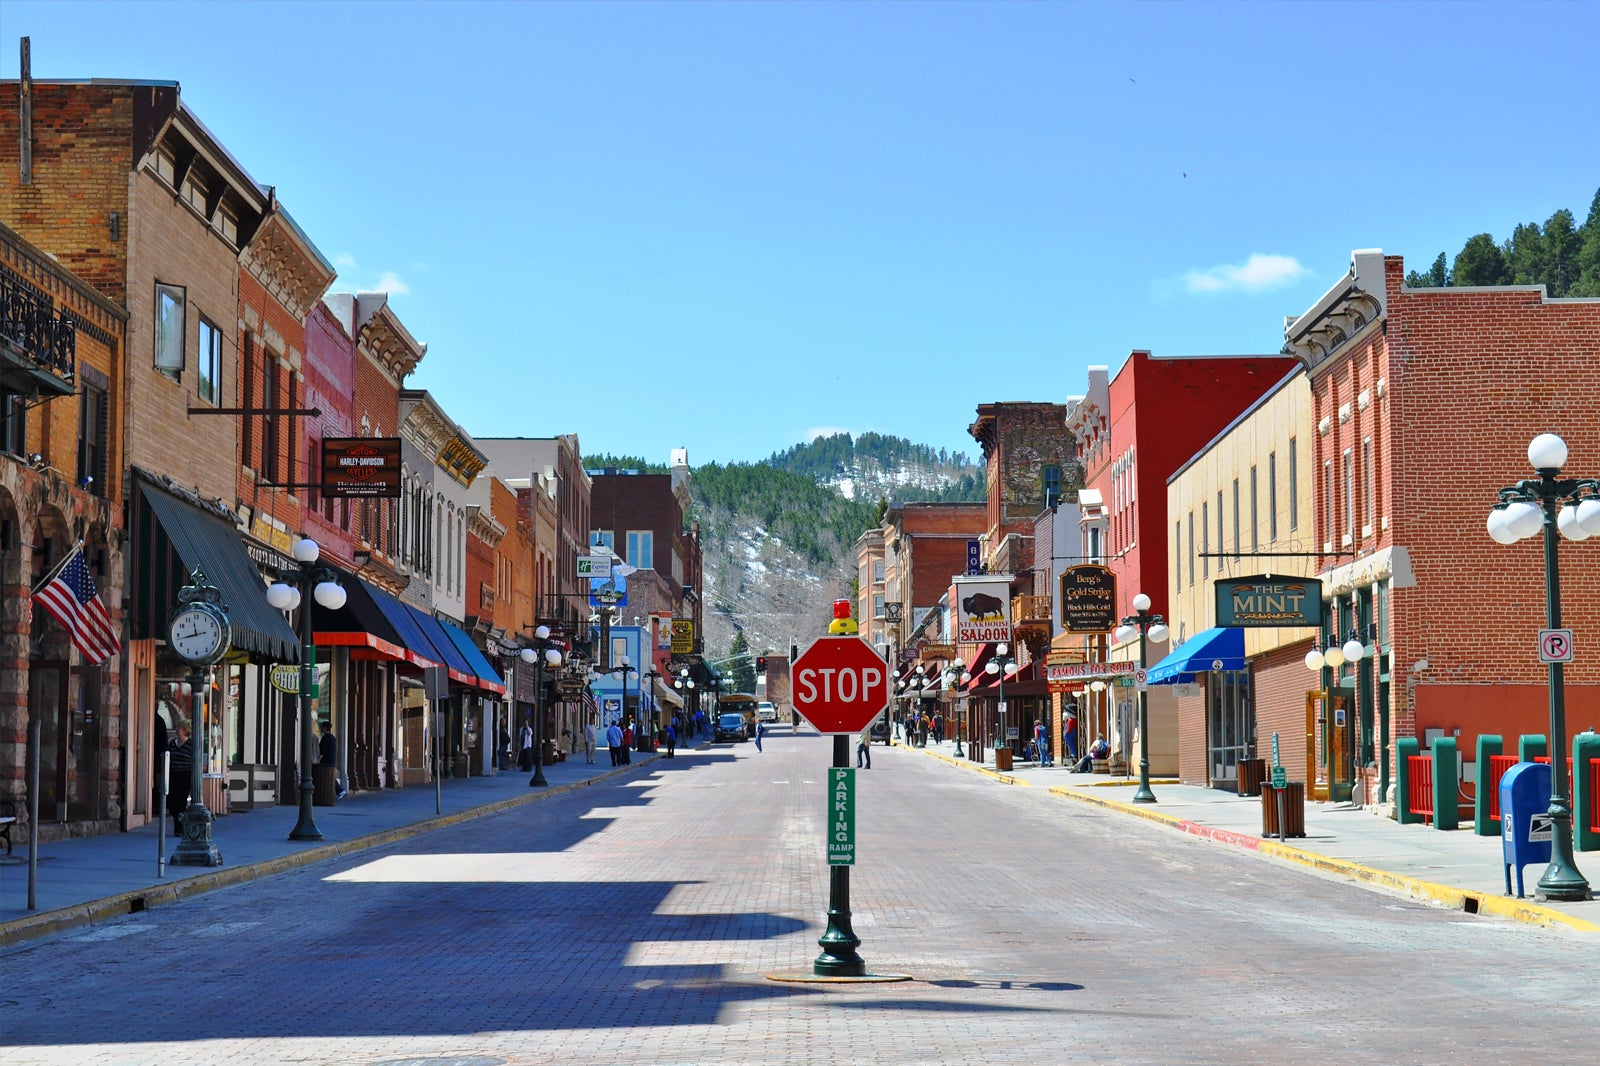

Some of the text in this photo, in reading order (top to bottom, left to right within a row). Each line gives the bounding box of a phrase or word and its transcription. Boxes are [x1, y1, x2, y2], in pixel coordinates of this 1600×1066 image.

[339, 457, 384, 466] HARLEY-DAVIDSON
[1076, 575, 1101, 585] Berg's
[1066, 587, 1111, 596] Gold Strike
[1252, 585, 1283, 594] THE
[1233, 595, 1305, 613] MINT
[960, 628, 1009, 642] SALOON
[1052, 665, 1085, 677] FAMOUS
[1088, 664, 1106, 675] FOR
[798, 667, 882, 703] STOP
[835, 771, 848, 841] PARKING
